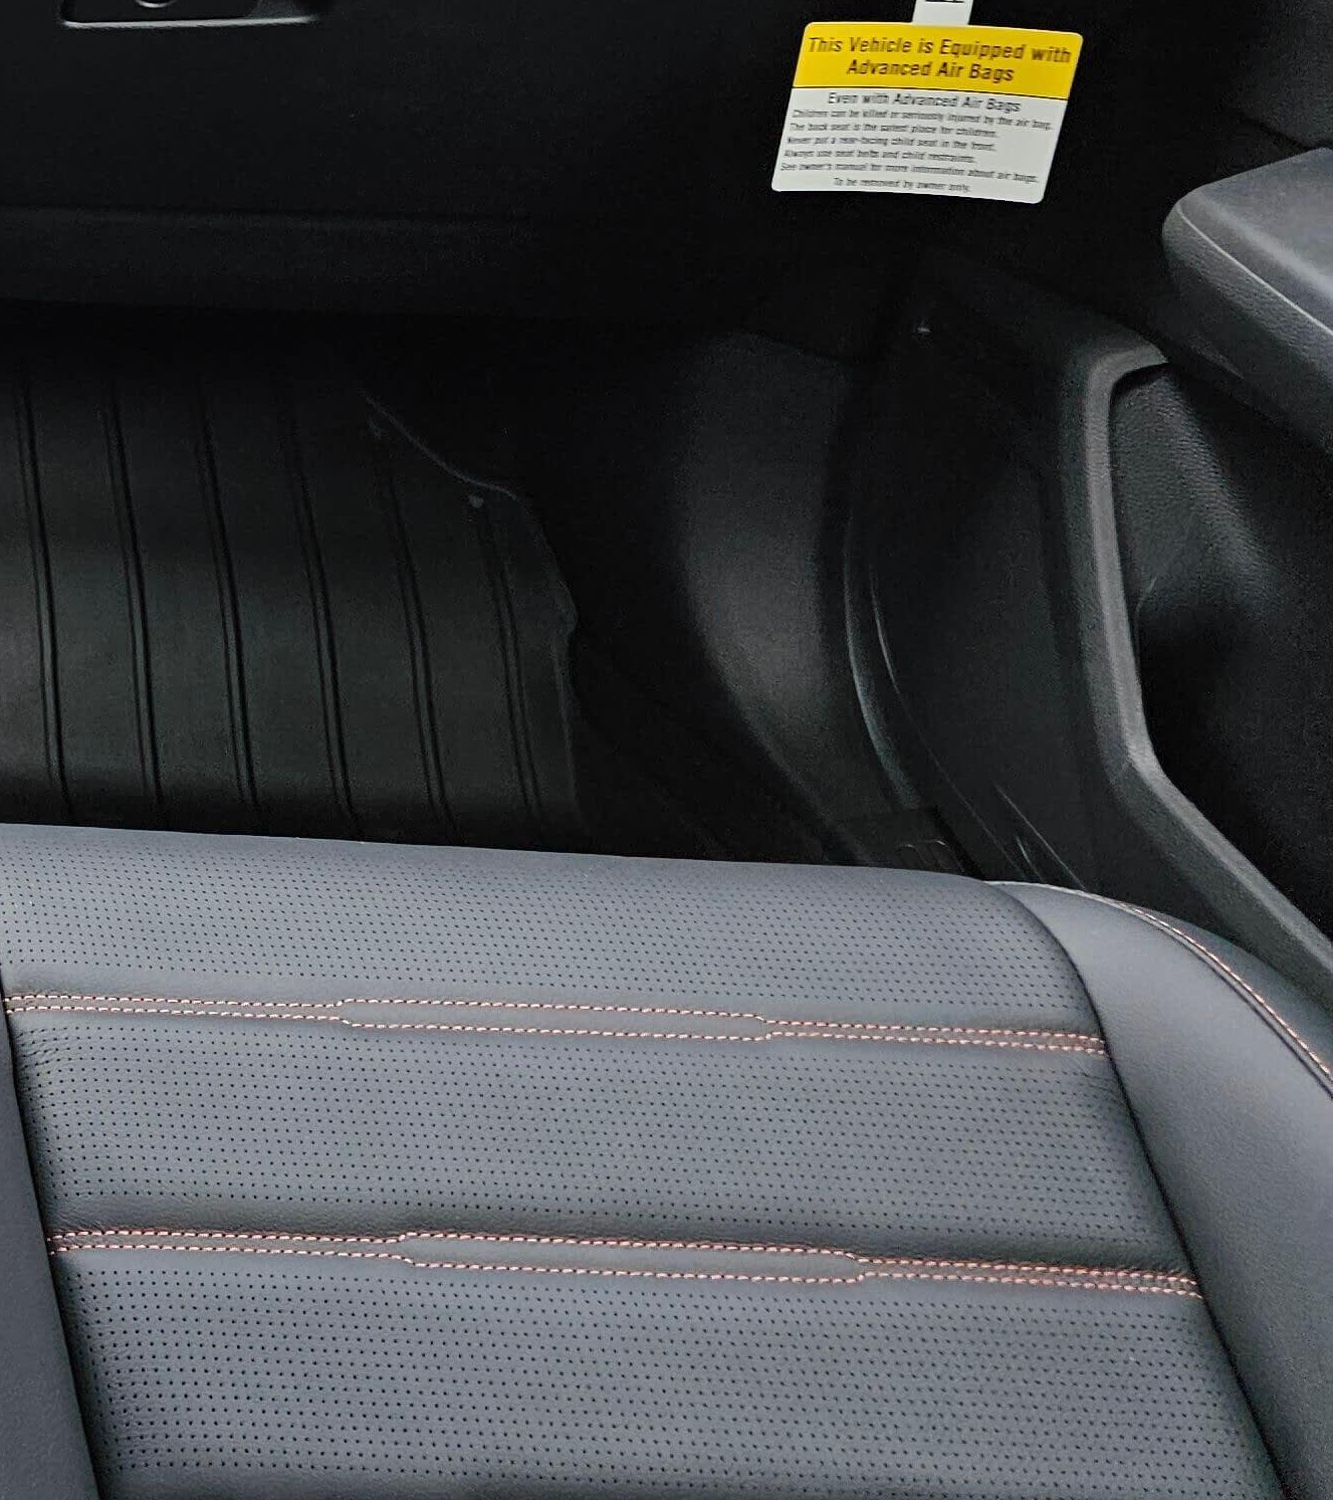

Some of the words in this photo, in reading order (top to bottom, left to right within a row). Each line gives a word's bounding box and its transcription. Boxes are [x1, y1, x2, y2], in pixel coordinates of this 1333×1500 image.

[808, 36, 843, 53] This
[849, 36, 912, 53] Vehicle
[917, 37, 934, 54] is
[938, 38, 1027, 61] Equipped
[1031, 46, 1071, 63] with
[846, 58, 933, 76] Advanced
[936, 61, 965, 78] Air
[969, 63, 1015, 84] Bags
[828, 91, 858, 105] Even
[861, 91, 889, 105] with
[892, 92, 958, 108] Advanced
[961, 95, 983, 109] Air
[986, 97, 1021, 115] Bags
